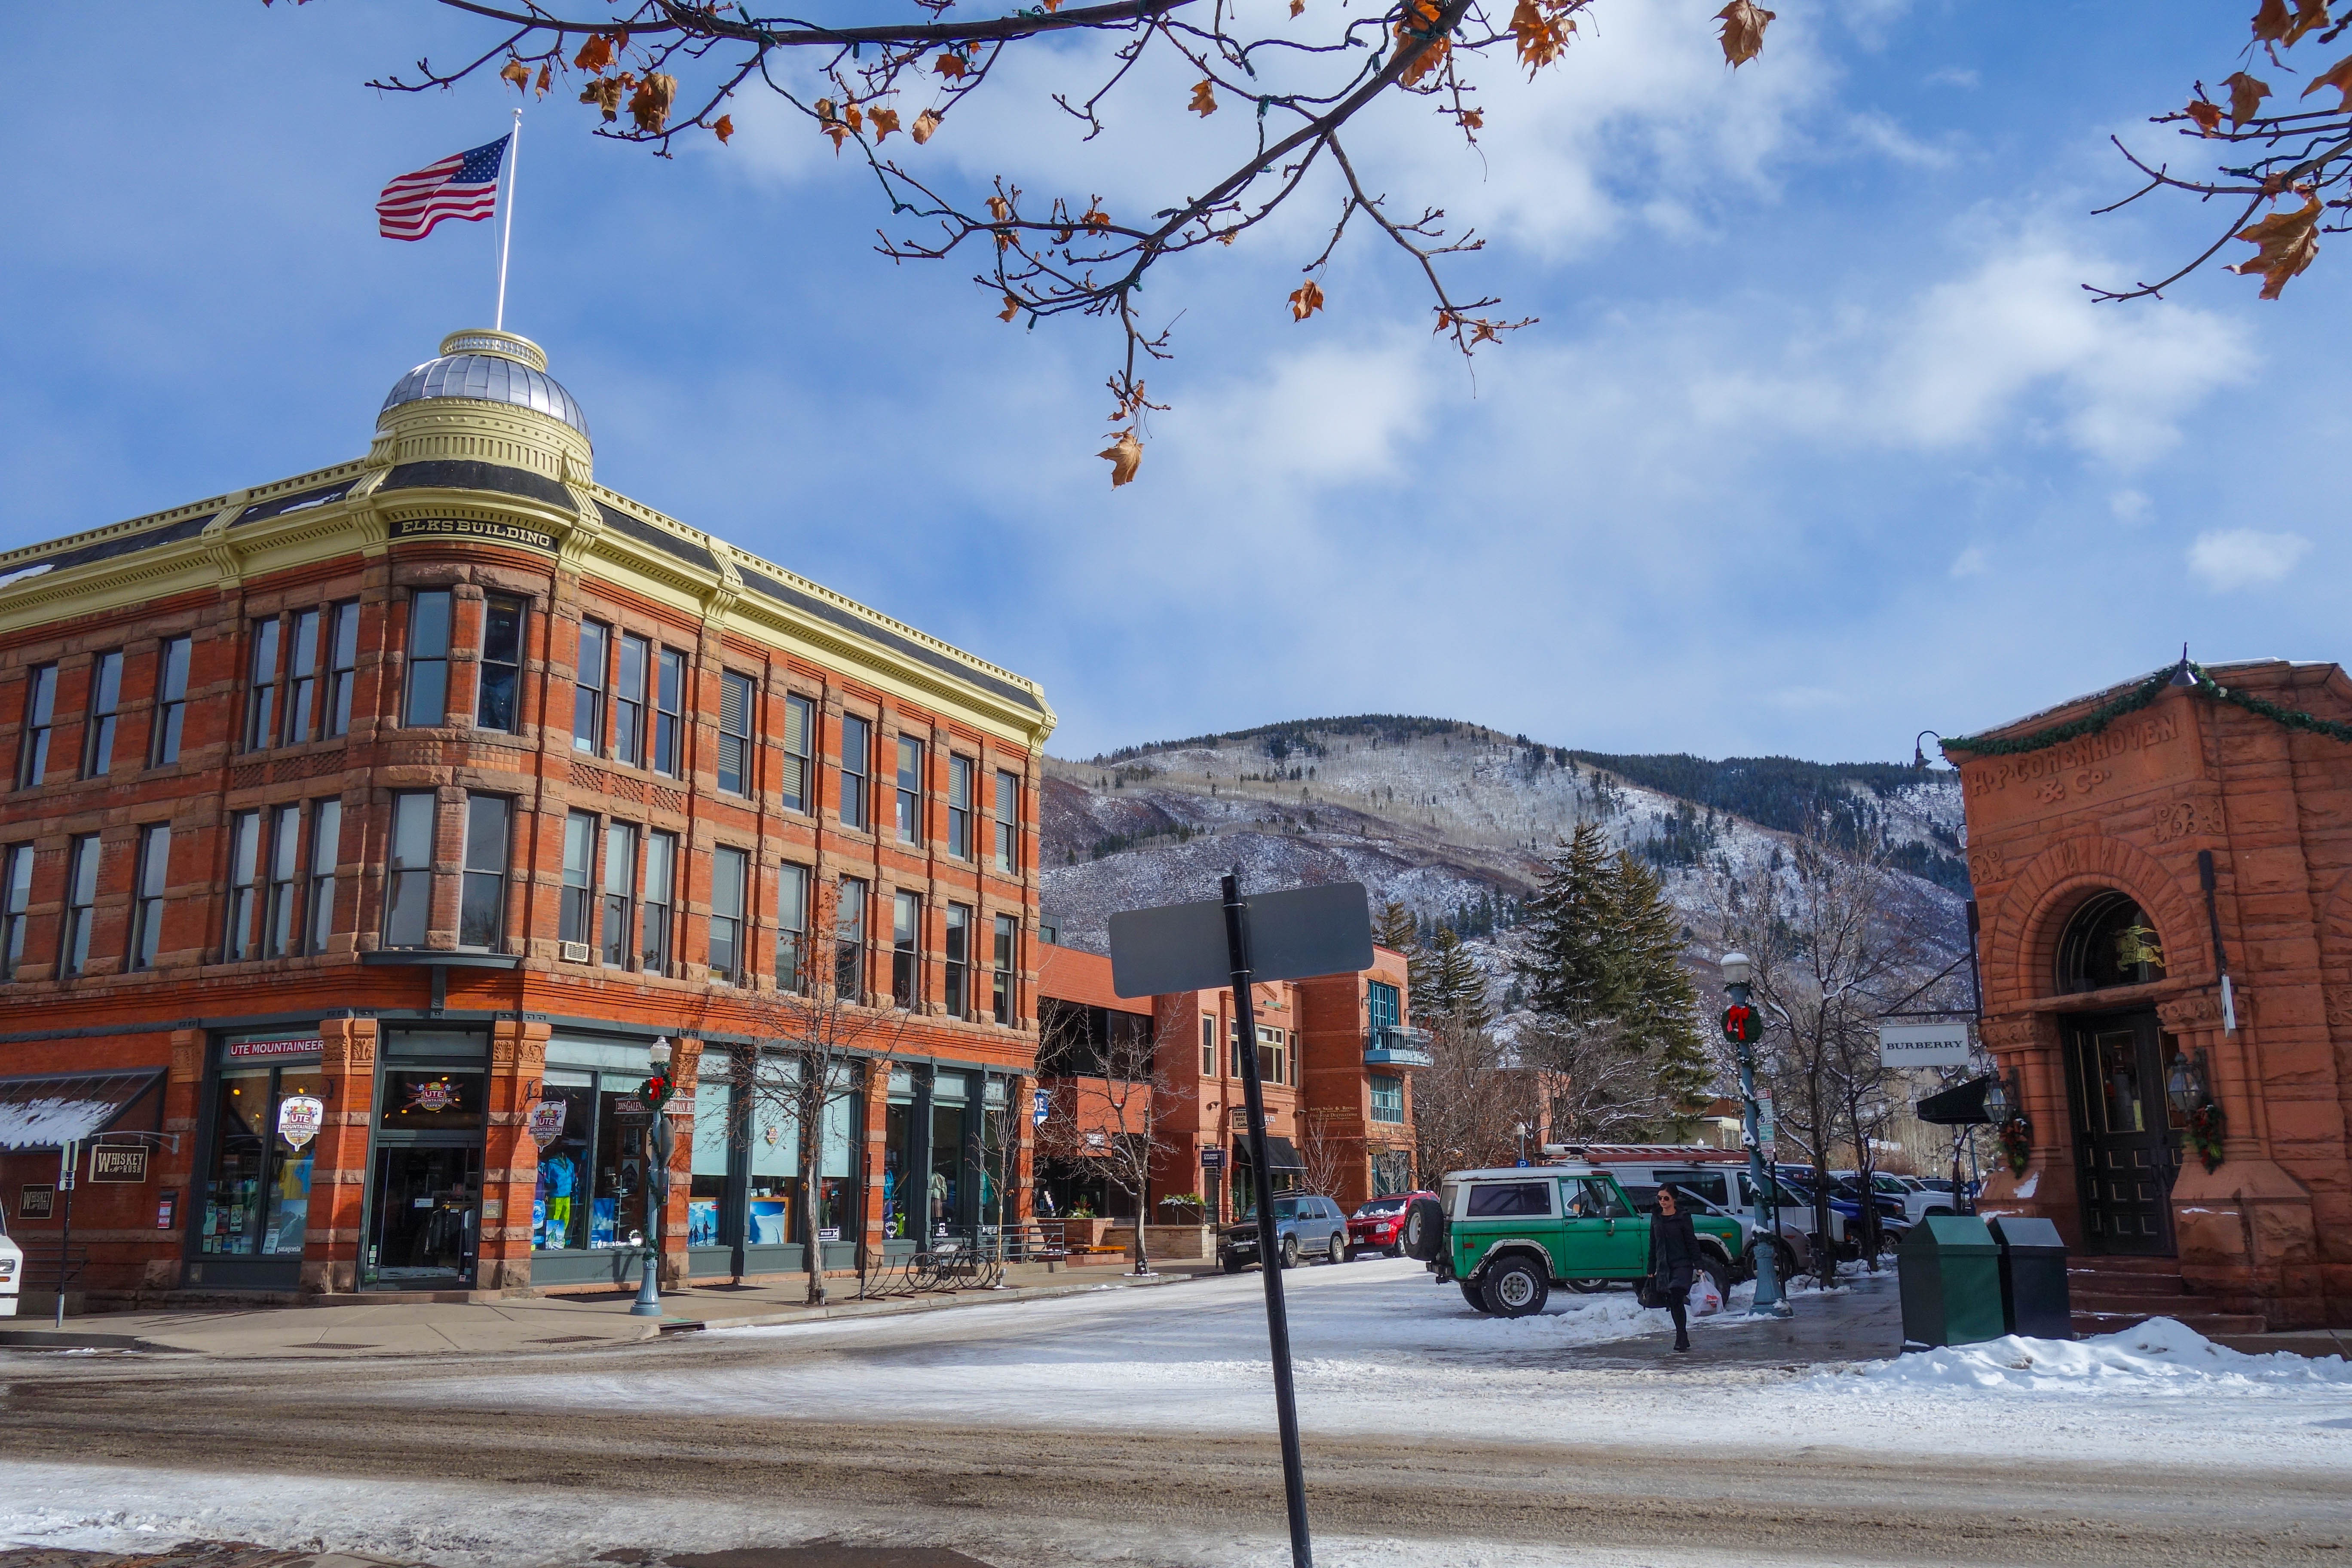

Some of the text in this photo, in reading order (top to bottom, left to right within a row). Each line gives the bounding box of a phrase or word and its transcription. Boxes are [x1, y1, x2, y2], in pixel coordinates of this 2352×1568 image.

[401, 520, 551, 547] ELKS BUILDING
[230, 1040, 323, 1055] UTE MOUNTAINEER
[1886, 1041, 1963, 1050] BURBERRY
[670, 1100, 686, 1112] HYMAN
[686, 1101, 694, 1112] AVE
[291, 1114, 311, 1123] UTE
[98, 1153, 144, 1173] WHISKEY
